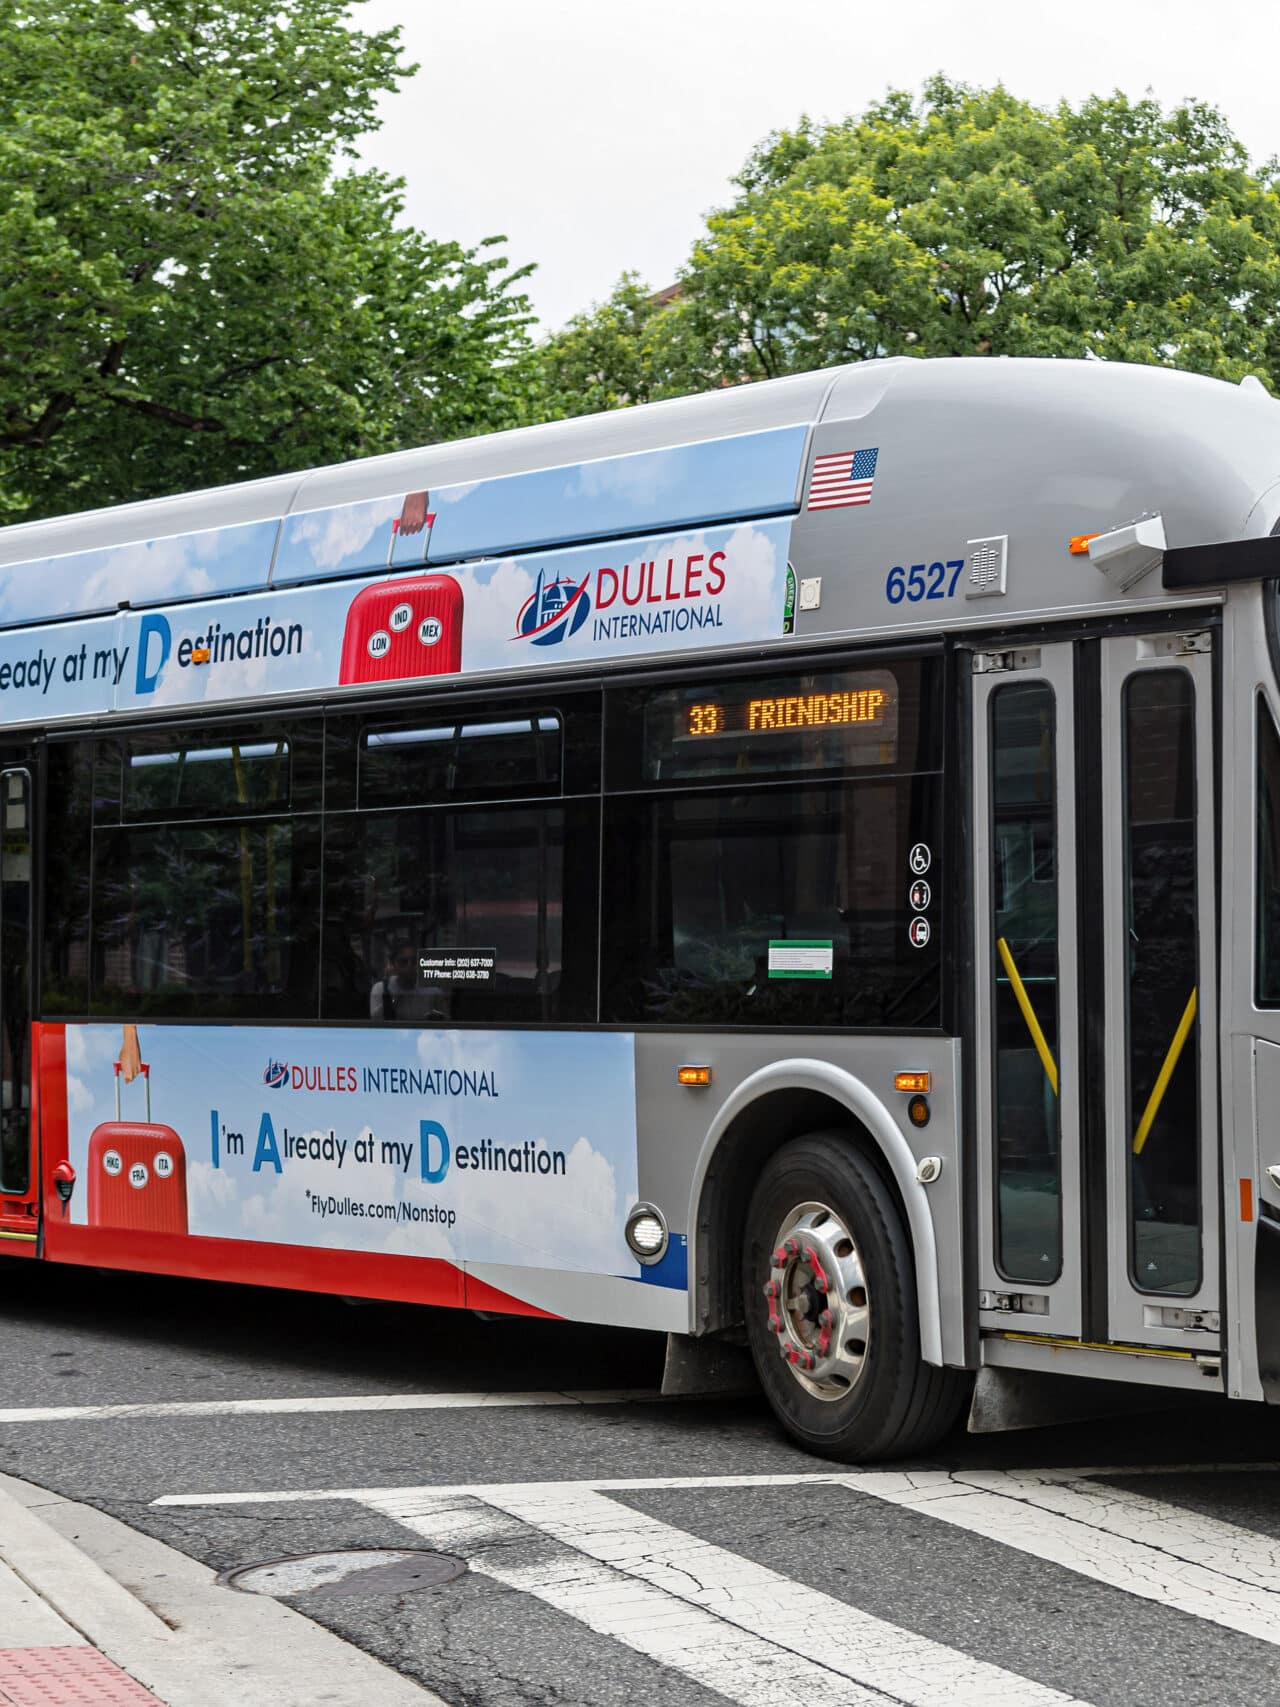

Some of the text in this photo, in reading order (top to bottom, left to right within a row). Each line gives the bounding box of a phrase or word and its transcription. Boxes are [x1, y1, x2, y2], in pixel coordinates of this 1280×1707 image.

[595, 551, 726, 610] DULLES
[886, 560, 964, 604] 6527
[394, 610, 408, 625] IND
[593, 604, 723, 641] INTERNATIONAL
[421, 625, 439, 638] MEX
[372, 638, 387, 651] LON
[63, 644, 86, 682] at
[93, 647, 129, 685] my
[689, 690, 885, 735] 33 FRIENDSHIP
[420, 958, 444, 967] Customer
[423, 970, 433, 978] TTY
[434, 970, 452, 978] Phone:
[292, 1066, 499, 1097] DULLES INTERNATIONAL
[211, 1110, 244, 1169] I'm
[354, 1133, 375, 1163] at
[382, 1141, 413, 1173] my
[132, 1169, 145, 1181] FRA
[158, 1159, 169, 1170] ITA
